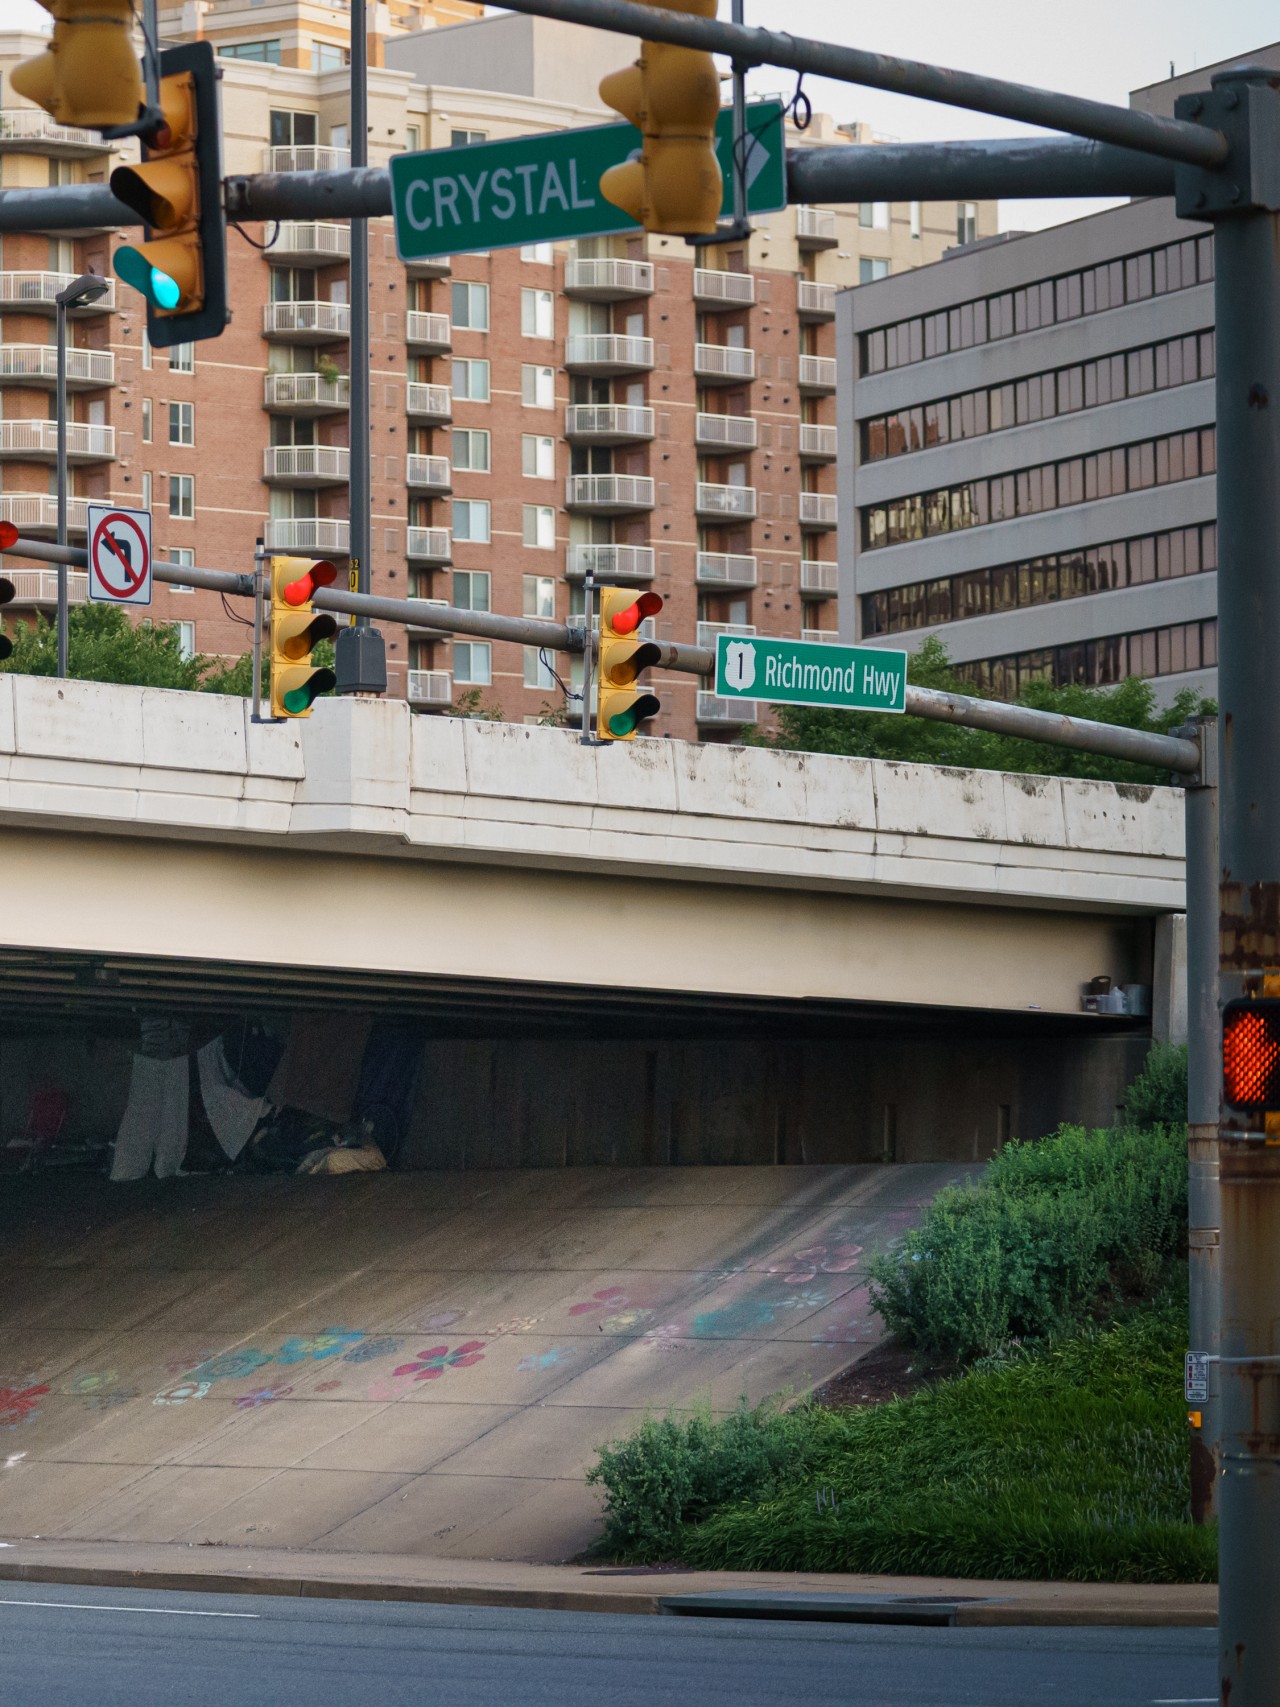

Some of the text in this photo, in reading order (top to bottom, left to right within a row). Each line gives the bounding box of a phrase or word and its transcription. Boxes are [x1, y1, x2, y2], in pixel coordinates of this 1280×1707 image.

[405, 158, 595, 231] CRYSTAL
[738, 652, 900, 706] 1 Richmond Hwy
